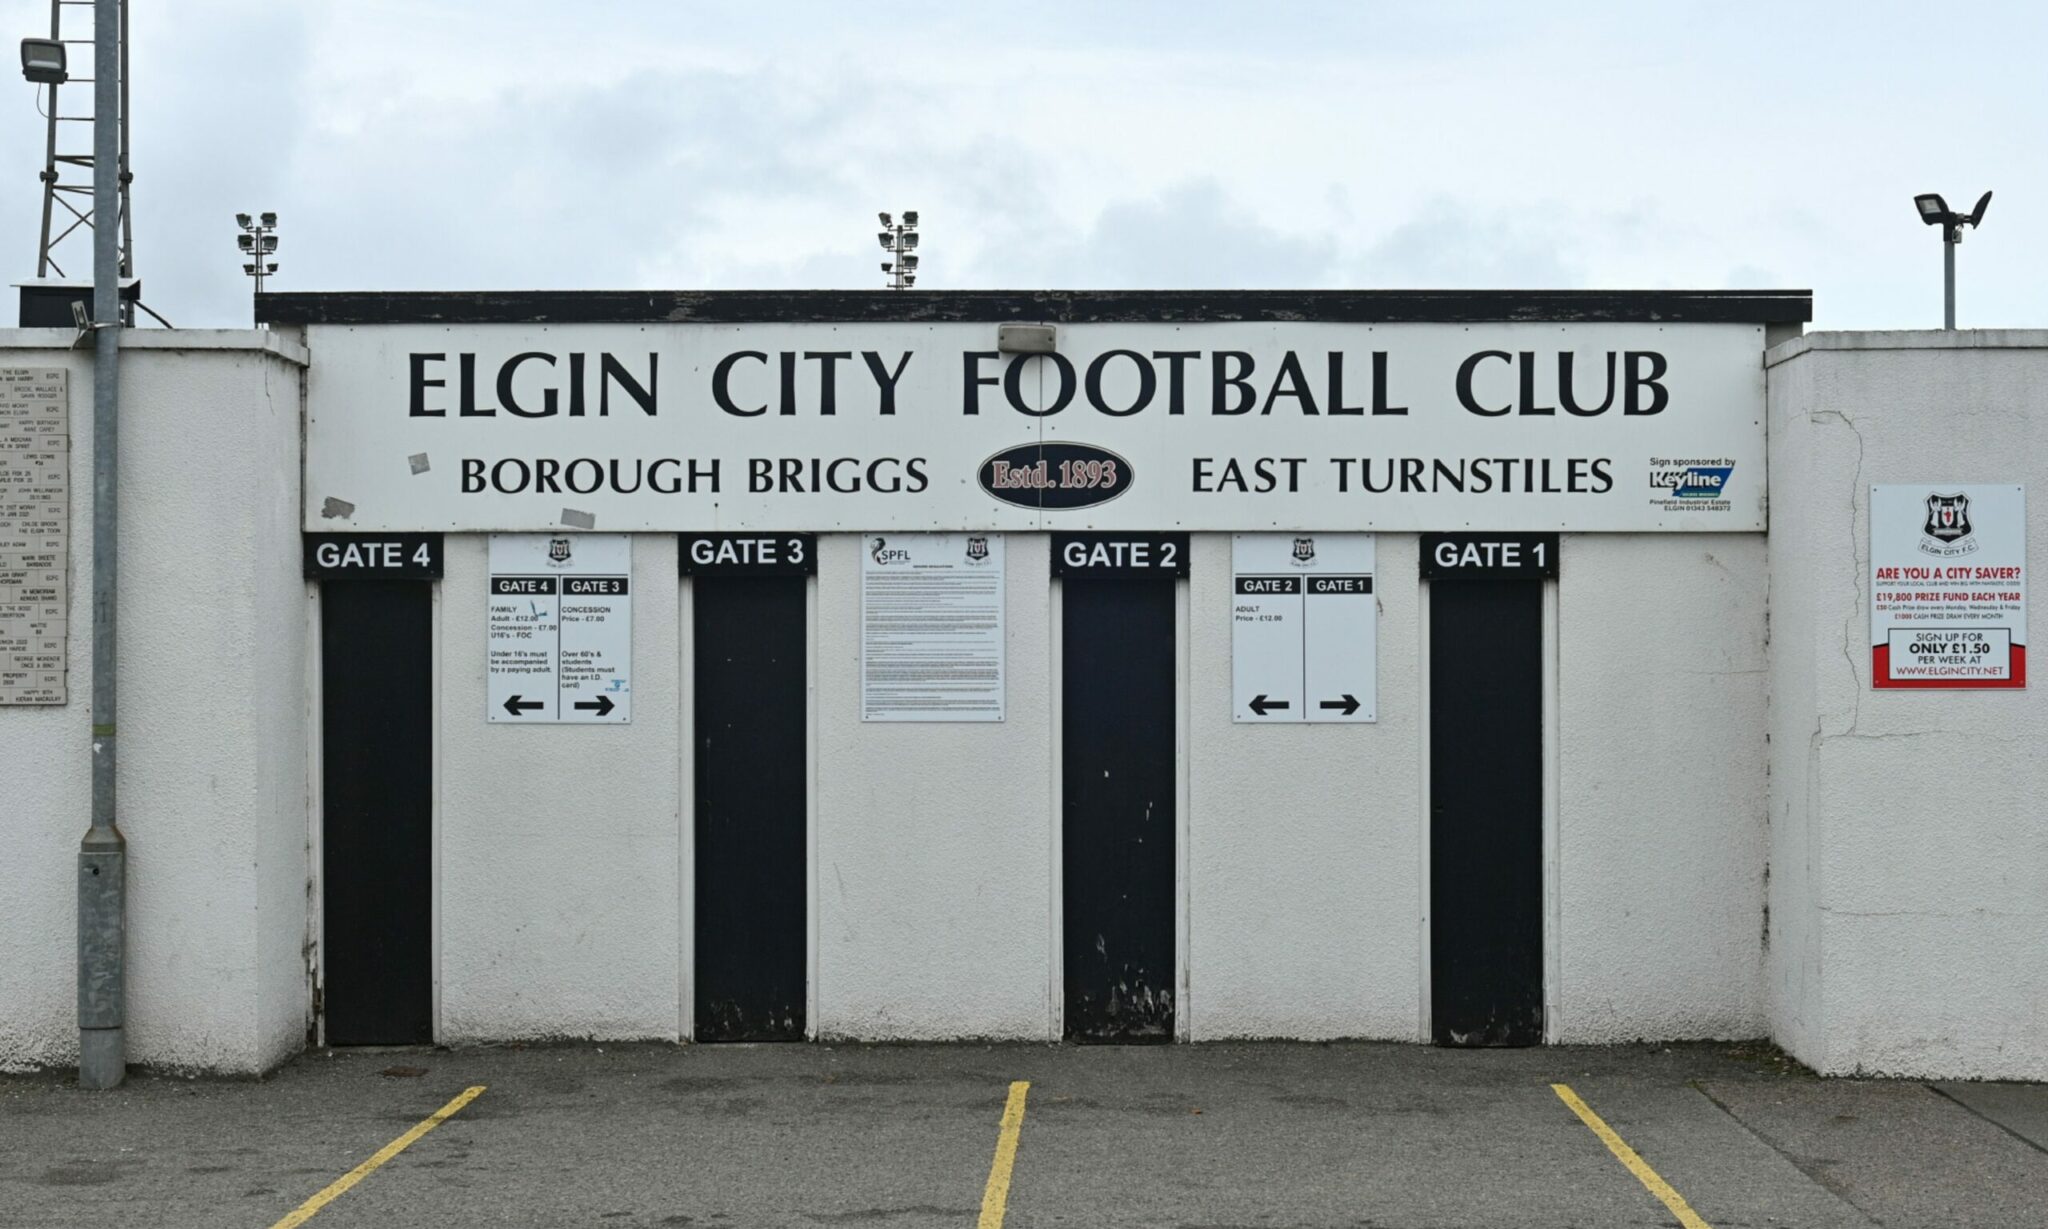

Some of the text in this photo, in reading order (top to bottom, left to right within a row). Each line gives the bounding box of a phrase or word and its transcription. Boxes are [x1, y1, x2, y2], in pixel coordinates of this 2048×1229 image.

[410, 350, 1668, 418] ELGIN CITY FOOTBALL CLUB
[1650, 457, 1736, 467] Sign sponsored by
[462, 458, 928, 493] BOROUGH BRIGGS
[992, 460, 1117, 488] Estd. 1893
[1193, 458, 1613, 493] EAST TURNSTILES
[1650, 472, 1722, 490] Keyline
[691, 540, 803, 564] GATE 3
[1064, 542, 1176, 567] GATE 2
[1921, 544, 1942, 555] ELGIN
[1962, 543, 1976, 553] F.C.
[317, 543, 430, 567] GATE 4
[882, 550, 911, 560] SPFL
[1436, 543, 1544, 567] GATE 1
[1876, 567, 2021, 580] ARE YOU A CITY SAVER?
[500, 581, 549, 592] GATE 4
[571, 581, 620, 592] GATE 3
[1244, 581, 1293, 592] GATE 2
[1316, 580, 1364, 591] GATE 1
[1876, 593, 2020, 603] £19,800 PRIZE FUND EACH YEAR
[1916, 633, 1983, 642] SIGN UP FOR
[1909, 643, 1990, 654] ONLY £1.50
[1918, 656, 1982, 664] PER WEEK AT
[1896, 667, 2004, 675] WWW.ELGINCITY.NET
